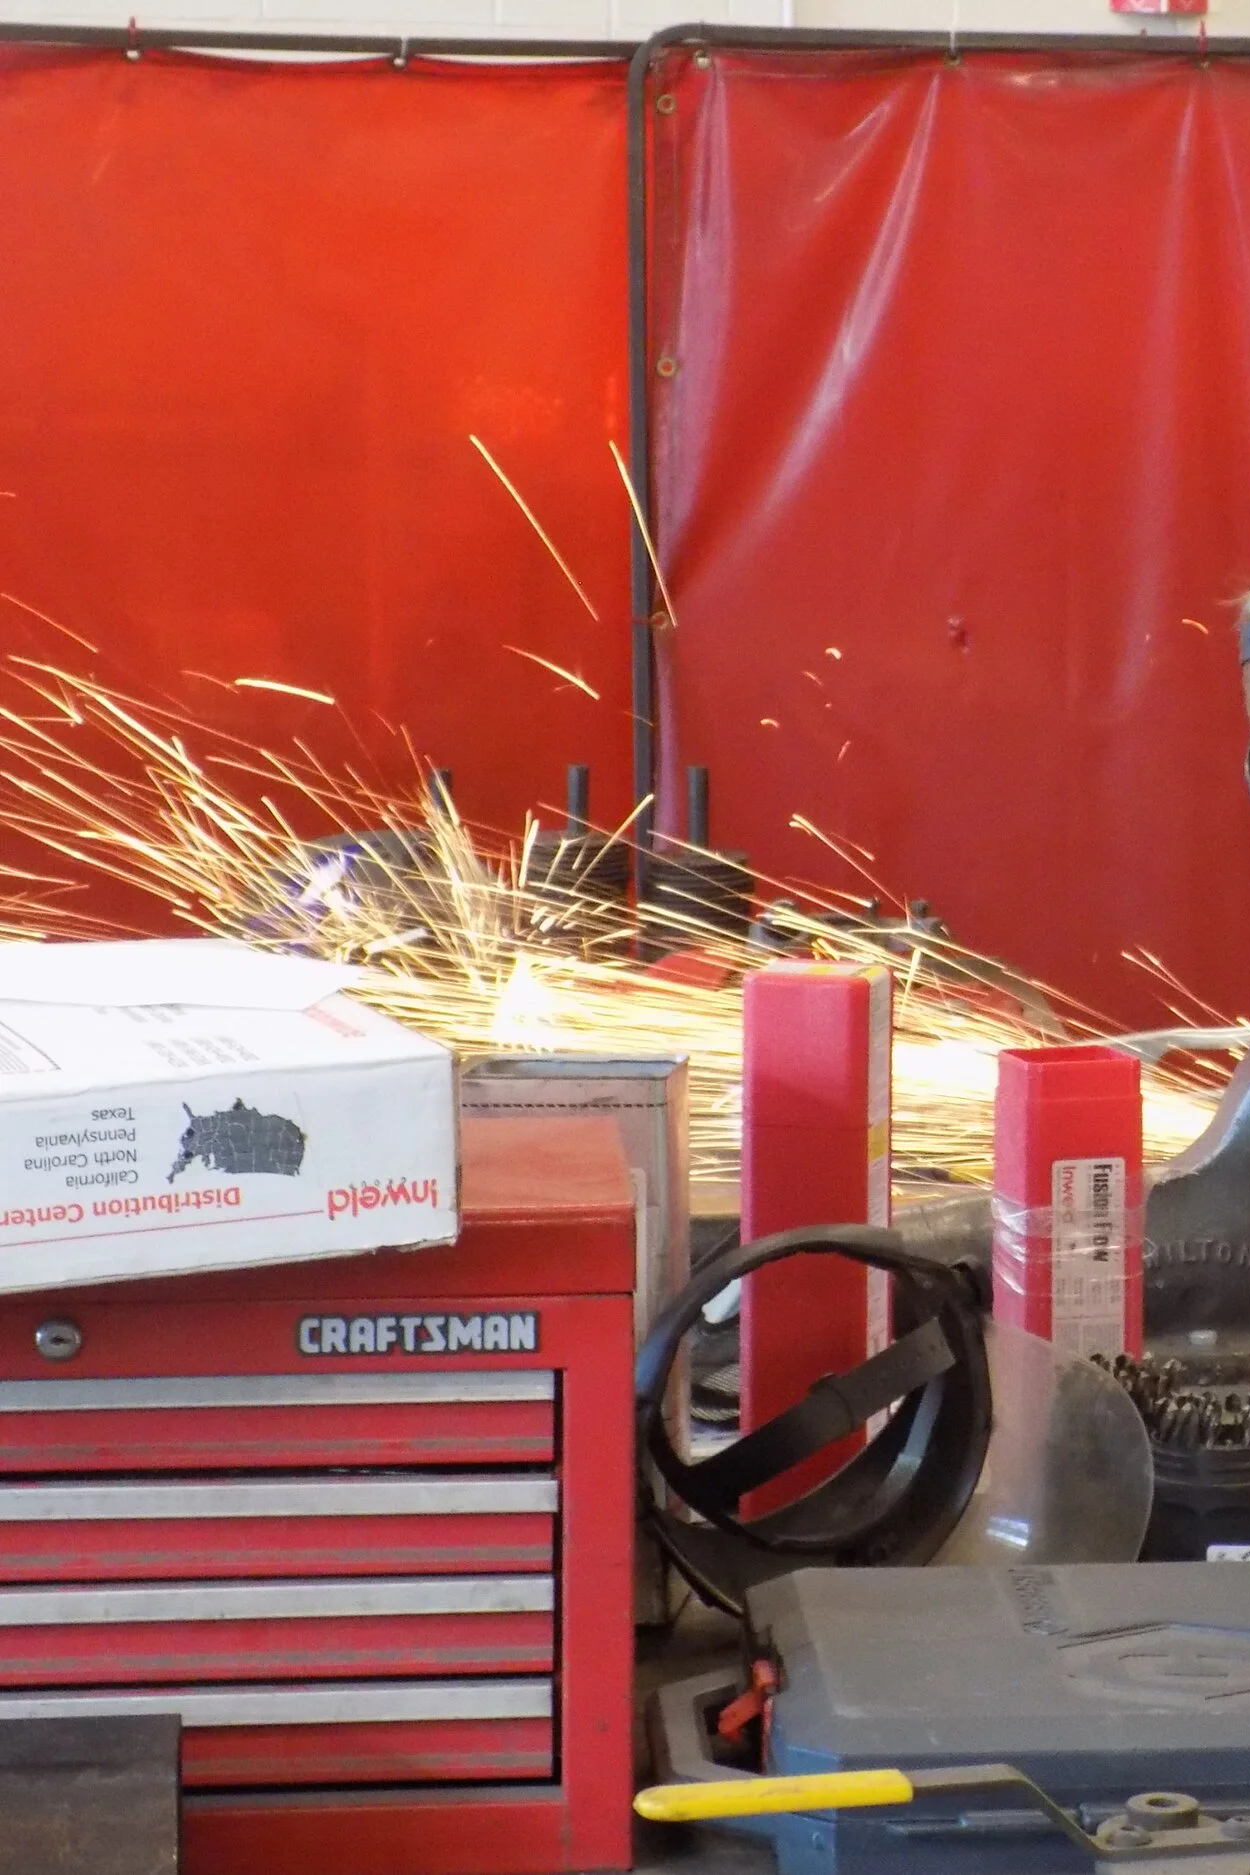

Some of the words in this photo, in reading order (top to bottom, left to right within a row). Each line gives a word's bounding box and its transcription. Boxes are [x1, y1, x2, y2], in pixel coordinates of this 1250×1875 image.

[91, 1107, 136, 1121] Texas
[35, 1127, 136, 1148] Pennsylvania
[24, 1153, 88, 1171] Carolina
[94, 1149, 138, 1165] North
[65, 1169, 139, 1189] California
[92, 1187, 240, 1217] Distribution
[327, 1178, 438, 1221] Inweld
[299, 1314, 537, 1354] CRAFTSMAN
